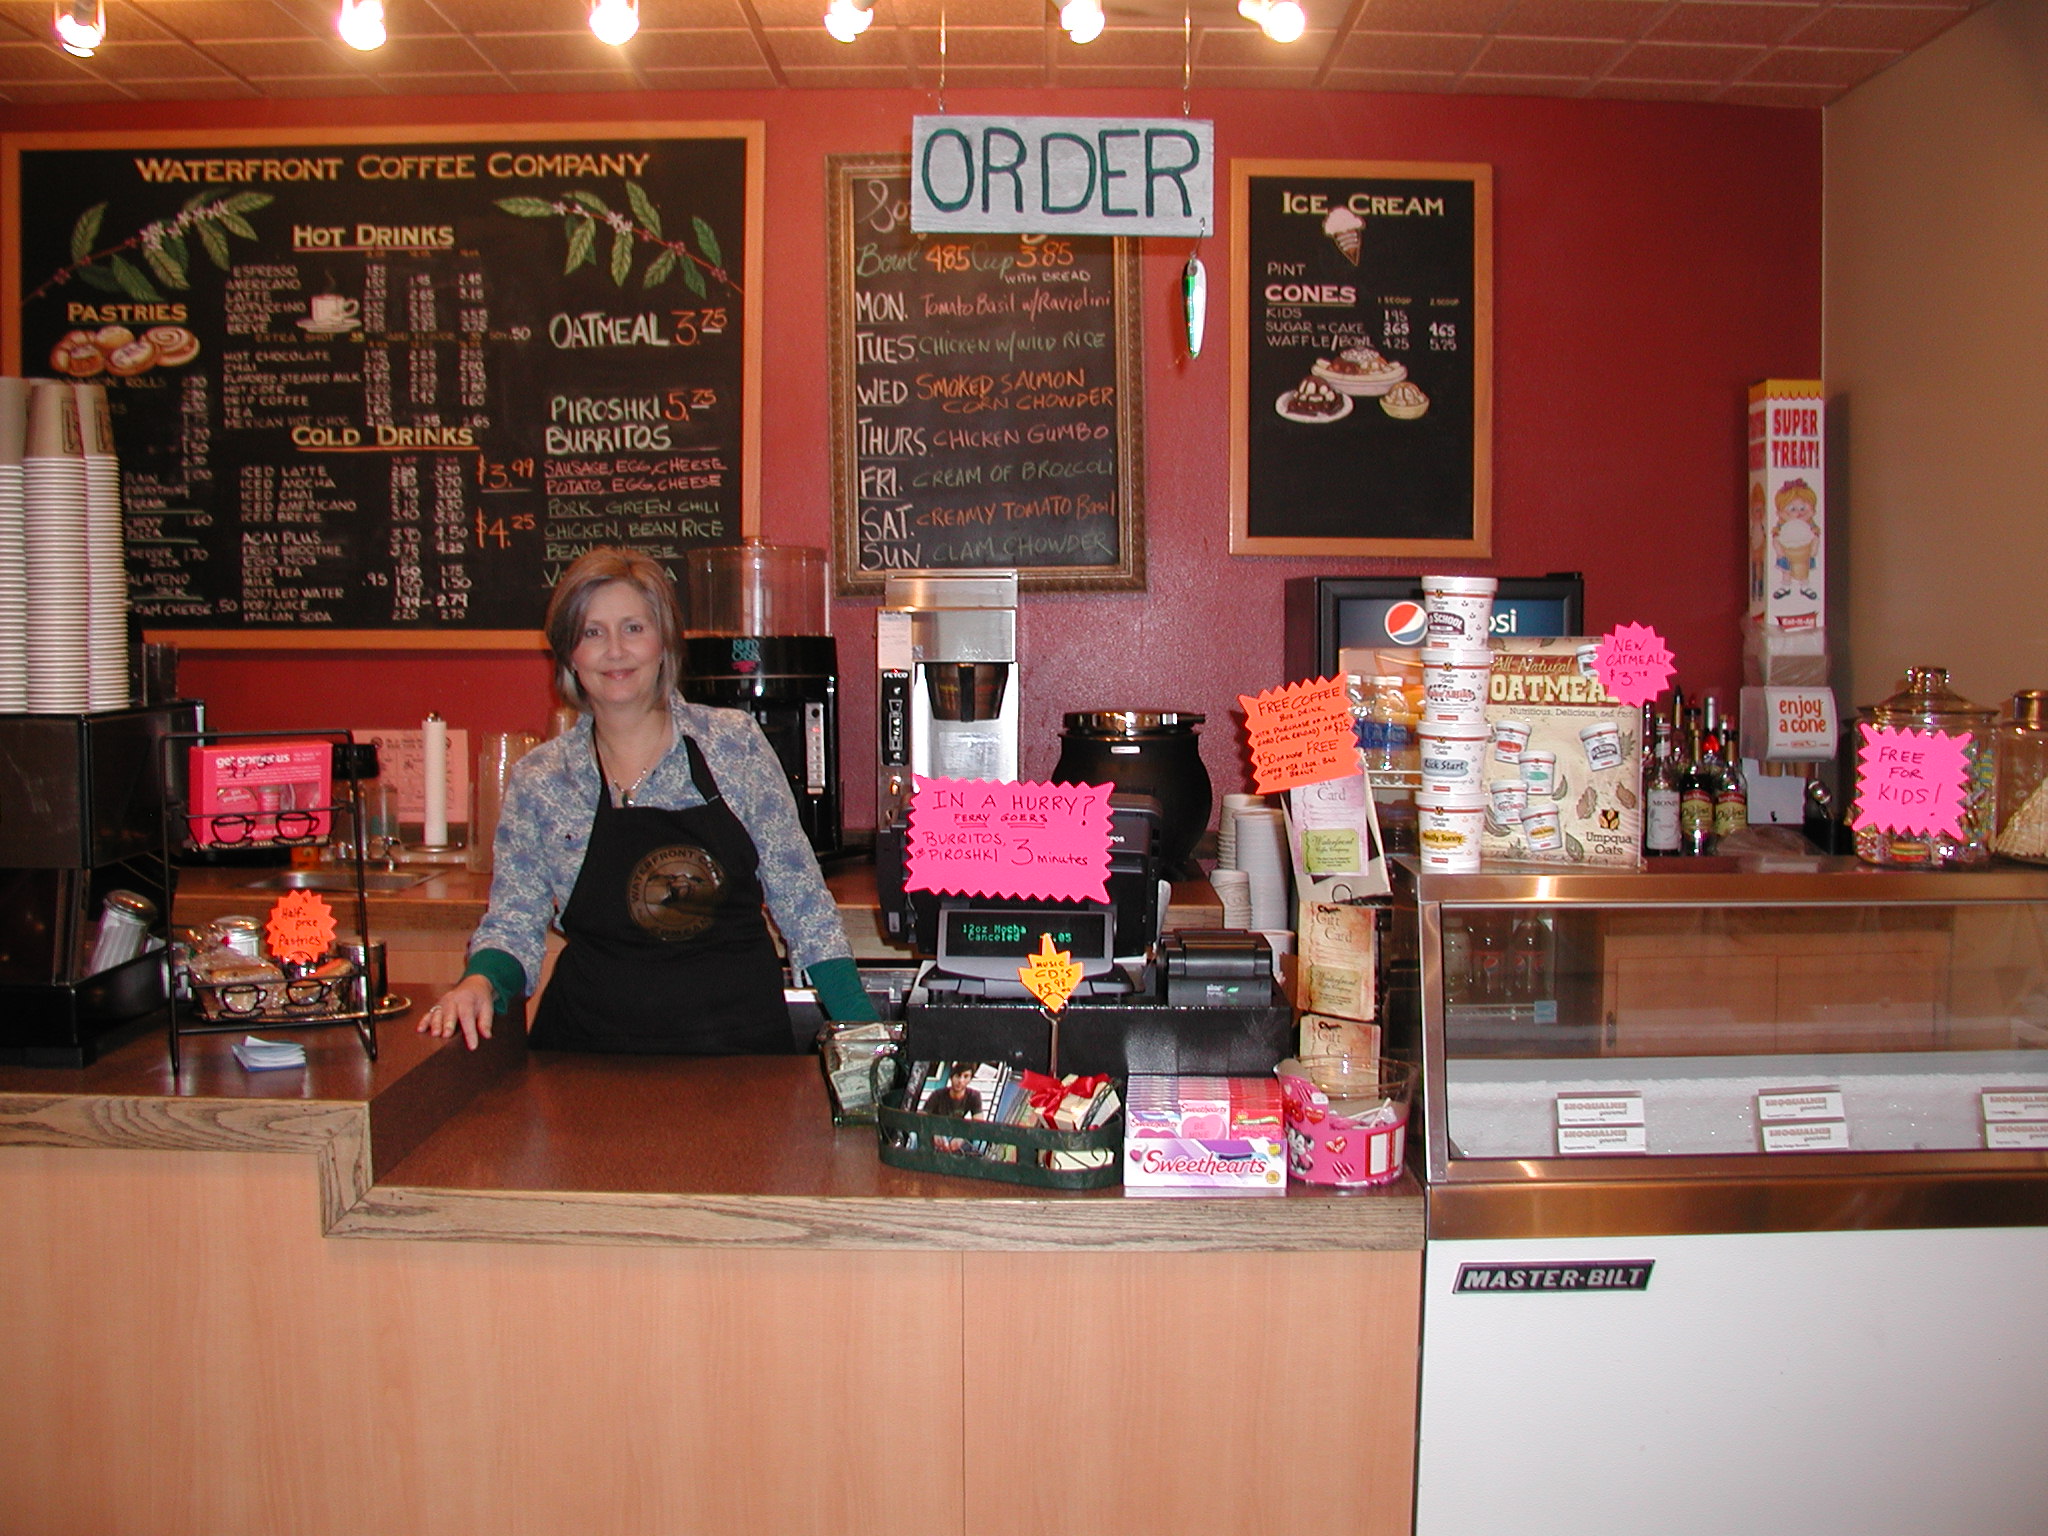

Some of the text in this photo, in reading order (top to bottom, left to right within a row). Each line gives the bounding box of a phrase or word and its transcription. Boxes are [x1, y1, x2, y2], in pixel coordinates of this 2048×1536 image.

[134, 153, 650, 183] WATERFRONT COFFEE COMPANY
[922, 128, 1200, 218] ORDER
[1283, 192, 1445, 217] ICE CREAM
[293, 225, 454, 247] HOT DRINKS
[232, 265, 298, 278] ESPRESSO
[857, 242, 918, 278] Bowl
[973, 242, 1015, 290] Cup
[1266, 262, 1307, 277] PINT
[225, 279, 301, 291] AMERICANO
[1004, 268, 1092, 287] WITH BREAD
[1265, 285, 1357, 303] CONES
[67, 303, 188, 323] PASTRIES
[856, 291, 909, 323] MON.
[977, 293, 1016, 316] Basil
[1265, 307, 1302, 320] KIDS
[550, 312, 669, 348] OATMEAL
[1264, 322, 1365, 335] SUGAR CAKE
[919, 335, 991, 357] CHICKEN
[254, 352, 331, 362] CHOCOLATE
[857, 368, 1087, 407] WED SMOKED SALMON
[258, 395, 310, 407] COFFEE
[551, 394, 661, 424] PIROSHKI
[943, 387, 1115, 413] CORN CHOWDER
[1774, 409, 1818, 437] SUPER
[291, 424, 475, 447] COLD DRINKS
[545, 424, 672, 455] BURRITOS
[933, 429, 1021, 453] CHICKEN
[1028, 421, 1110, 447] GUMBO
[1773, 441, 1820, 469] TREAT!
[240, 466, 328, 478] ICED LATTE
[475, 453, 535, 489] $3.99
[653, 457, 728, 475] CHEESE
[861, 450, 1113, 499] FRI. CREAM OF BROCCOLI
[240, 478, 337, 490] ICED MOCHA
[657, 474, 722, 492] CHEESE
[240, 490, 314, 501] ICED CHAI
[240, 501, 358, 512] ICED AMERICANO
[547, 499, 594, 518] PORK
[604, 499, 671, 517] GREEN
[240, 512, 322, 523] ICED BREVE
[862, 504, 916, 543] SAT.
[916, 502, 998, 528] CREAMY
[1003, 498, 1073, 522] TOMATO
[475, 507, 536, 549] $4.25
[682, 518, 725, 538] RICE
[242, 531, 323, 545] ACAI PLUS
[934, 538, 999, 562] CLAM
[1003, 532, 1113, 557] CHOWDER
[242, 588, 345, 600] BOTTLED WATER
[244, 612, 334, 622] ITALIAN SODA
[1614, 640, 1643, 653] NEW
[1492, 656, 1574, 674] All Natural
[1491, 674, 1620, 703] OATMEA
[1258, 687, 1340, 717] FREE COFFEE
[1779, 695, 1822, 719] enjoy
[1779, 719, 1827, 733] a cone
[1306, 739, 1340, 756] FREE
[1879, 746, 1926, 764] FREE
[1889, 767, 1924, 781] FOR
[1317, 786, 1346, 801] Card
[931, 791, 1096, 828] IN A HURRY?
[954, 813, 1048, 825] FERRY GOERS
[922, 831, 1007, 848] BURRITOS,
[1586, 831, 1634, 857] Umpqua Oats
[928, 849, 999, 863] PIROSHKI
[1011, 838, 1089, 866] 3 minutes
[963, 923, 1028, 935] 12oz Mocha
[968, 932, 1021, 943] Canceled
[1036, 960, 1065, 969] MUSIC
[1143, 1150, 1268, 1175] Sweethearts
[1462, 1266, 1646, 1291] MASTER-BILT
